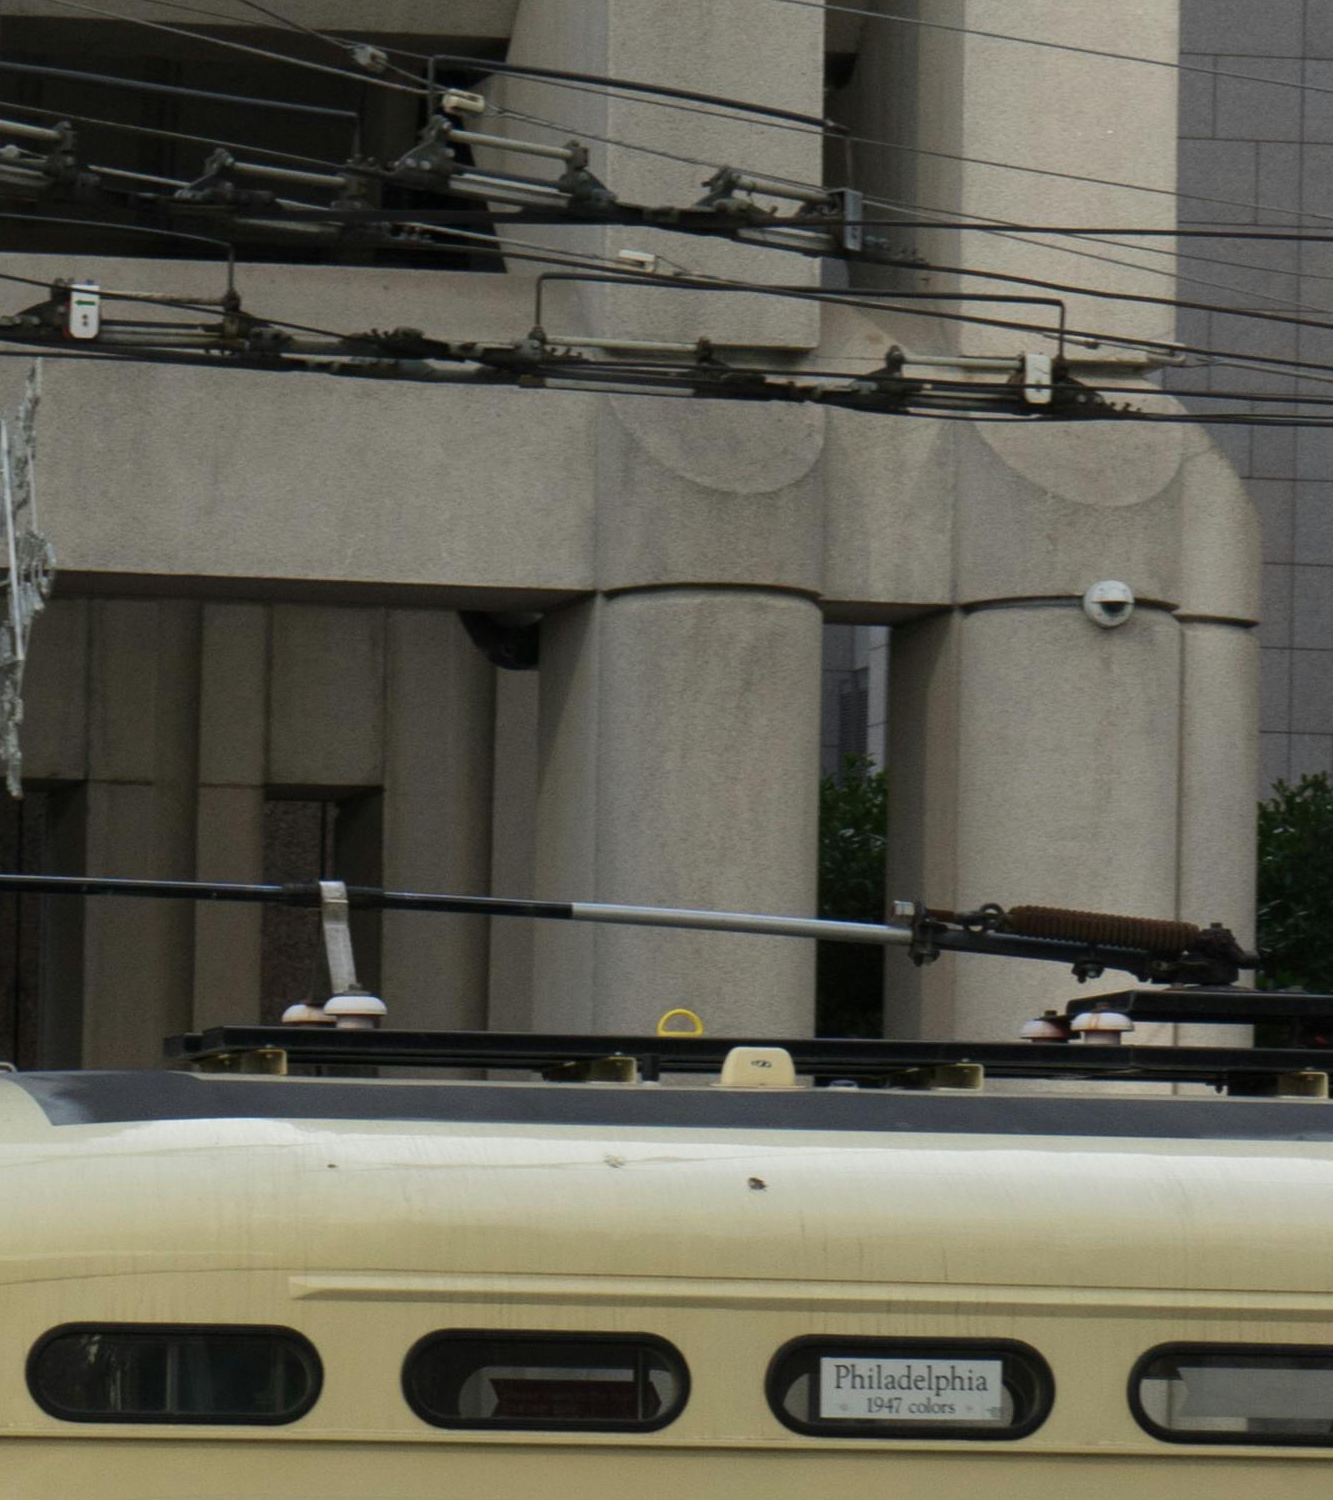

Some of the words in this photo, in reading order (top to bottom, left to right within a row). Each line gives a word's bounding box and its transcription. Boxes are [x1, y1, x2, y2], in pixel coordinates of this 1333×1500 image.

[834, 1363, 988, 1397] Philadelphia
[866, 1397, 903, 1414] 1947
[908, 1397, 956, 1414] colors
